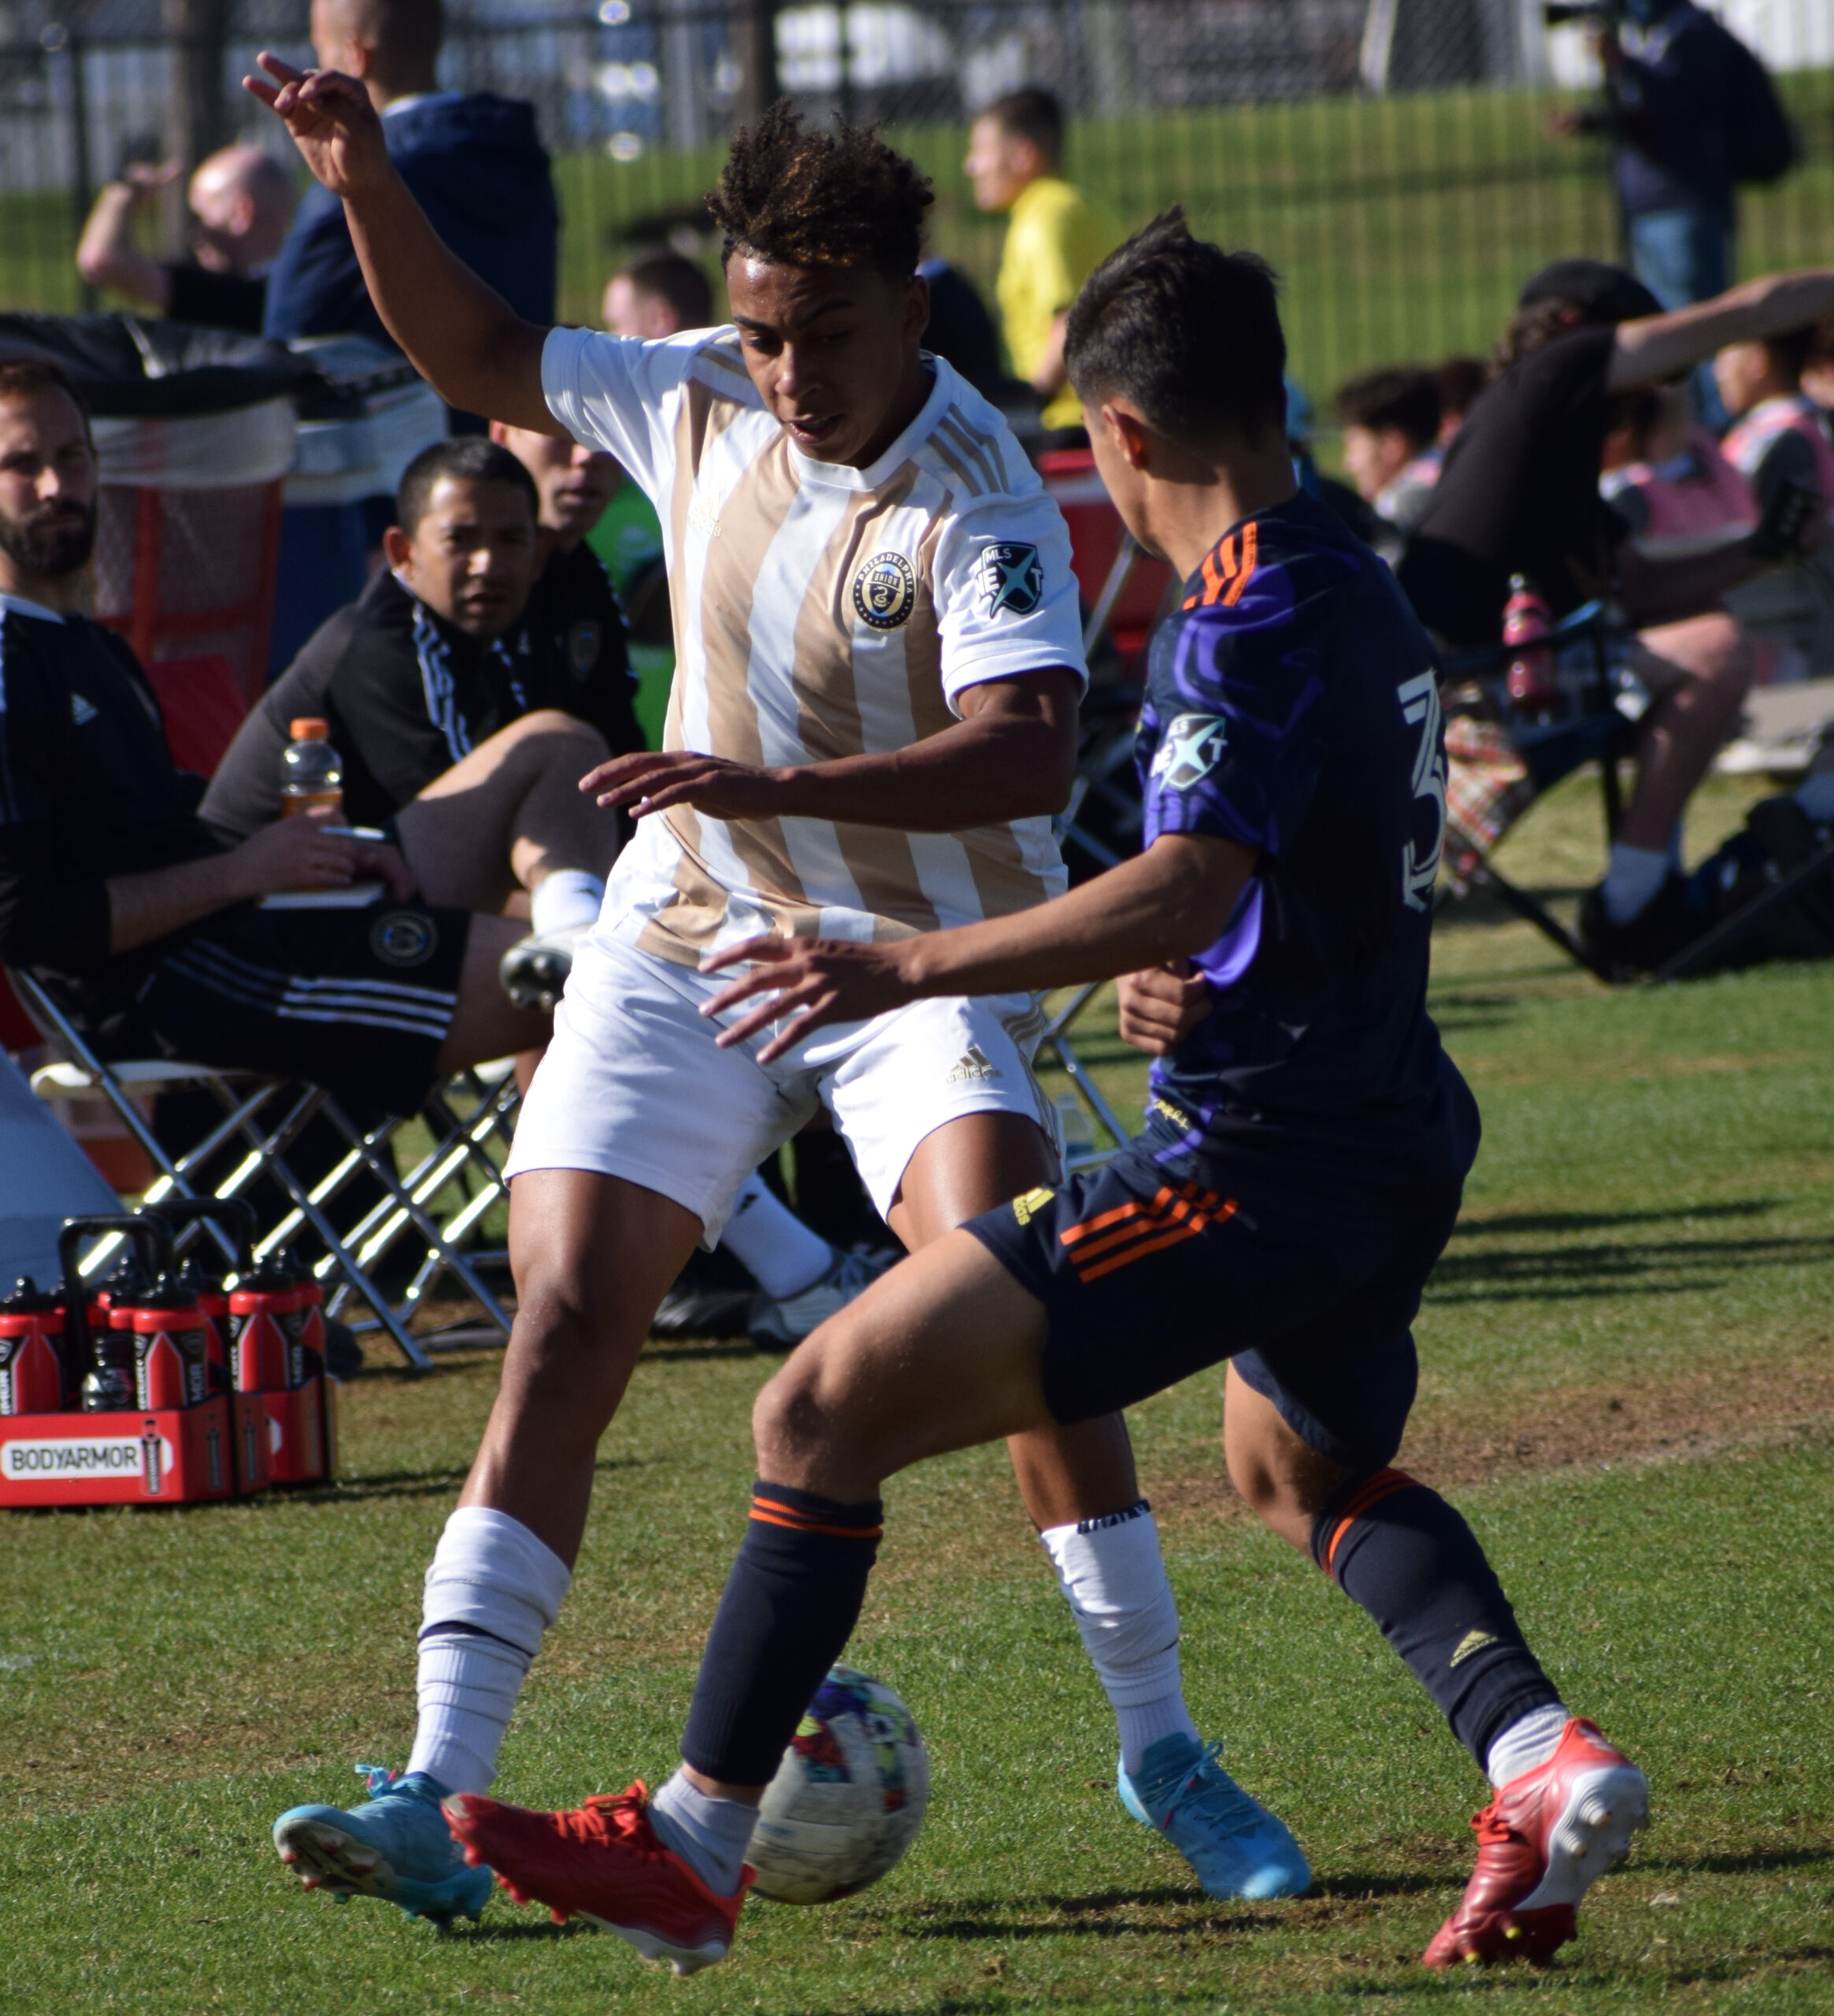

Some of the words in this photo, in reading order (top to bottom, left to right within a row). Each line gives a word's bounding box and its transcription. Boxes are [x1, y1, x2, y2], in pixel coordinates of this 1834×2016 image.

[986, 548, 1012, 563] MLS
[858, 554, 913, 594] PHILADELPHIA
[874, 573, 898, 587] UNION
[10, 1445, 139, 1471] BODYARMOR
